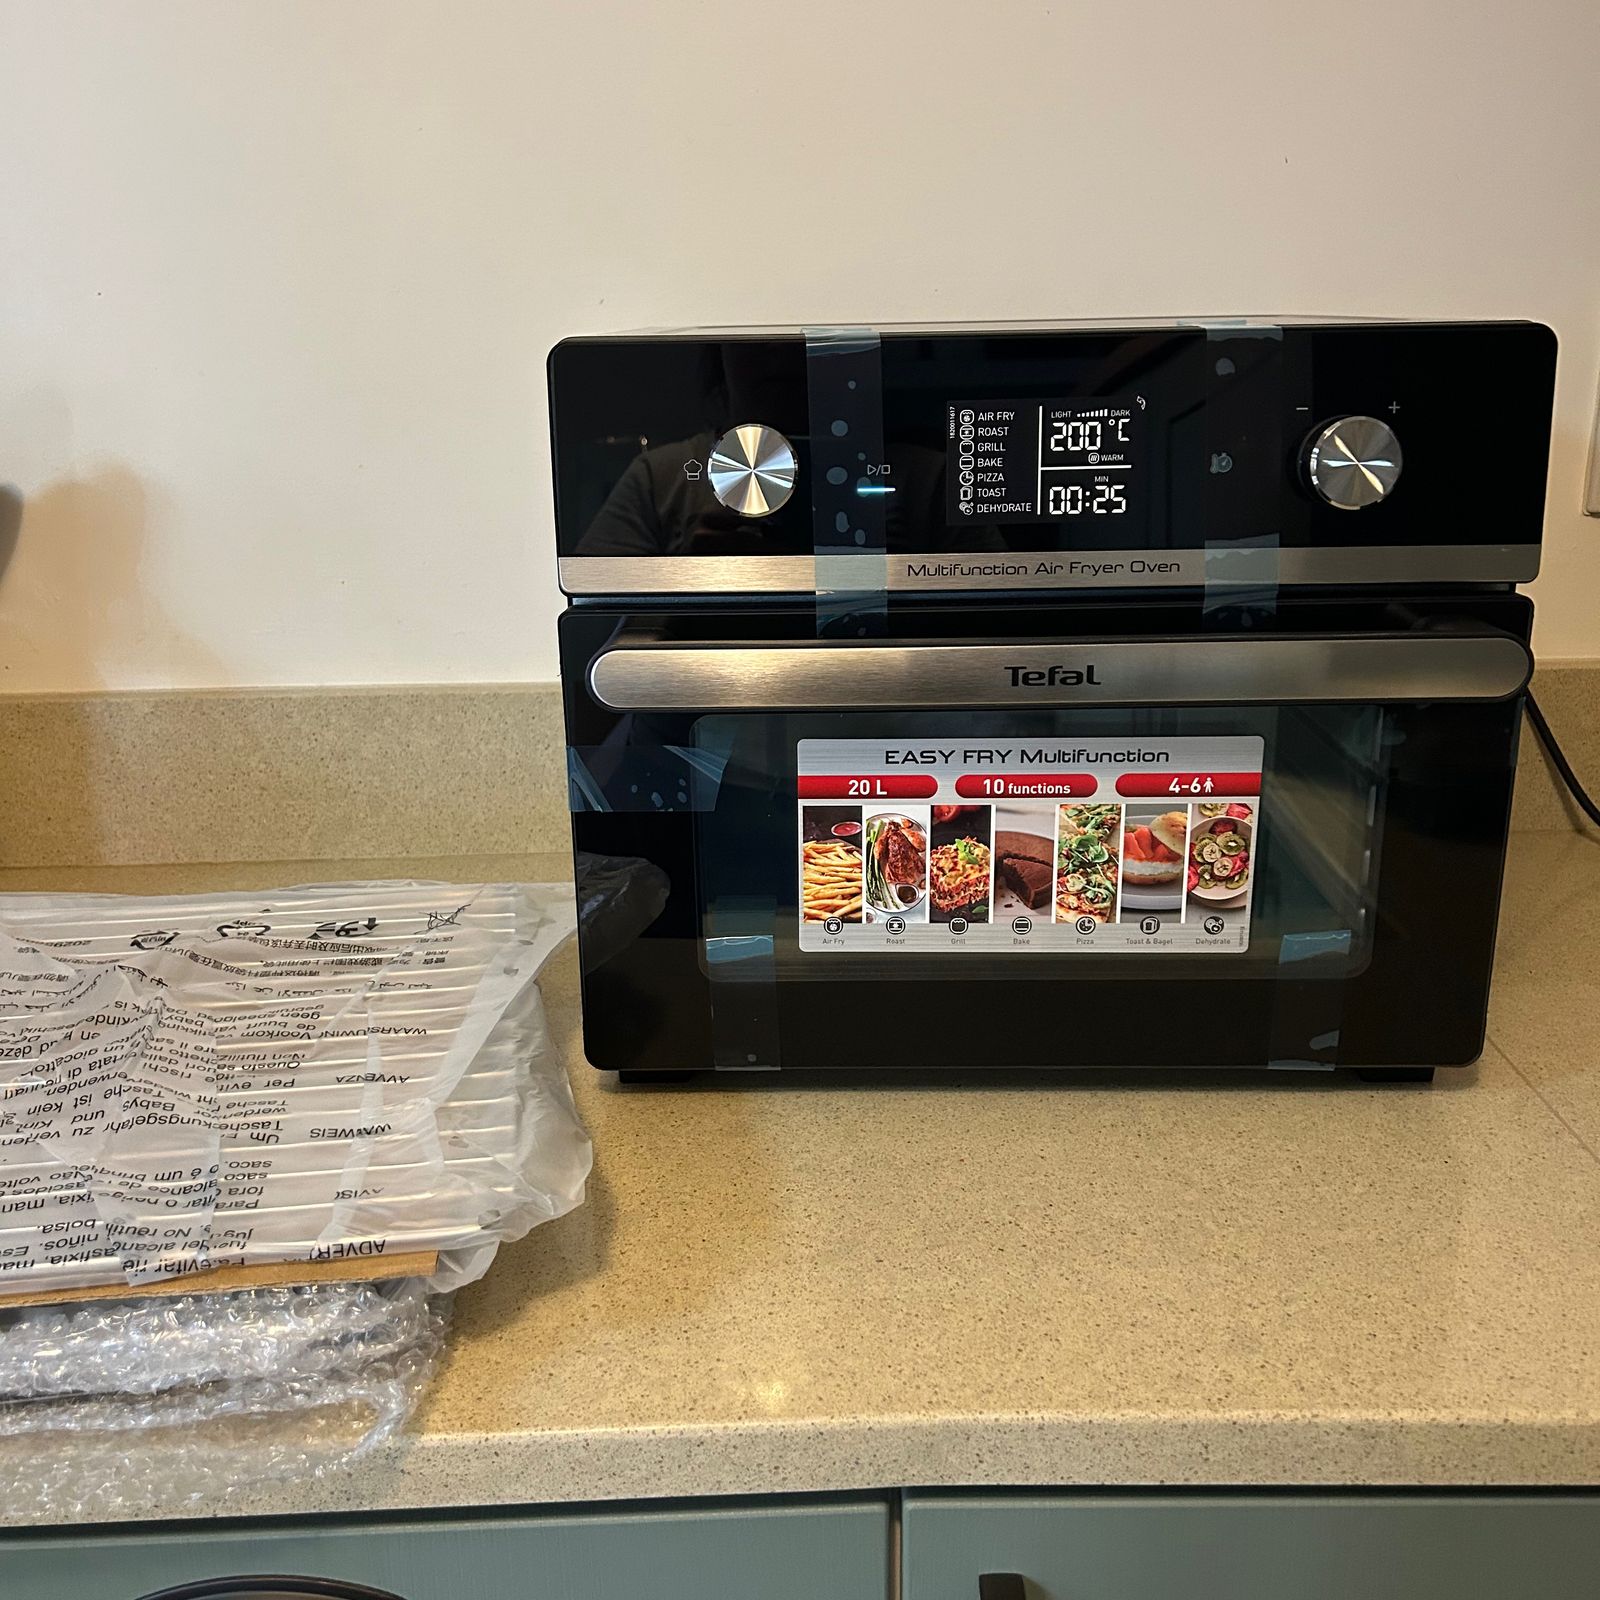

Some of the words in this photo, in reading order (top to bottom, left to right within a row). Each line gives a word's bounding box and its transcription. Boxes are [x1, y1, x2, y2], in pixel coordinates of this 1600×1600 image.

[977, 411, 996, 422] AIR
[996, 411, 1015, 420] FRY
[1051, 410, 1072, 418] LIGHT
[977, 426, 1010, 437] ROAST
[977, 442, 1006, 452] GRILL
[977, 458, 1004, 467] BAKE
[1101, 454, 1124, 462] WARM
[977, 473, 1005, 482] PIZZA
[976, 488, 1007, 497] TOAST
[1049, 484, 1126, 515] 00:25
[976, 502, 1032, 513] DEHYDRATE
[907, 562, 1028, 577] Multifunction
[1034, 562, 1064, 576] Air
[1069, 561, 1124, 577] Fryer
[1130, 560, 1181, 573] Oven
[1004, 664, 1101, 687] Tefal
[884, 749, 956, 765] EASY
[962, 748, 1014, 764] FRY
[1019, 748, 1170, 764] Multifunction
[848, 779, 872, 796] 20
[876, 779, 888, 796] L
[983, 778, 1005, 796] 10
[1008, 780, 1072, 795] functions
[1168, 777, 1201, 794] 4-6
[834, 938, 845, 946] Fry
[1153, 938, 1173, 946] Bagel
[1195, 938, 1231, 946] Dehydrate
[280, 1011, 320, 1020] geen
[246, 1020, 288, 1030] buurt
[296, 1023, 316, 1031] de
[240, 1030, 311, 1040] Voorkom
[68, 1066, 82, 1080] di
[264, 1078, 296, 1088] Per
[73, 1094, 92, 1110] ist
[26, 1102, 64, 1116] kein
[70, 1110, 105, 1125] und
[72, 1126, 95, 1137] zu
[250, 1132, 280, 1145] Um
[224, 1160, 273, 1169] saco.
[154, 1170, 183, 1182] um
[190, 1168, 202, 1180] é
[224, 1172, 268, 1181] saco
[12, 1181, 85, 1196] ascidos
[228, 1186, 264, 1196] fora
[165, 1199, 178, 1208] o
[36, 1218, 97, 1234] bolsa.
[163, 1227, 192, 1238] No
[40, 1233, 99, 1251] niños.
